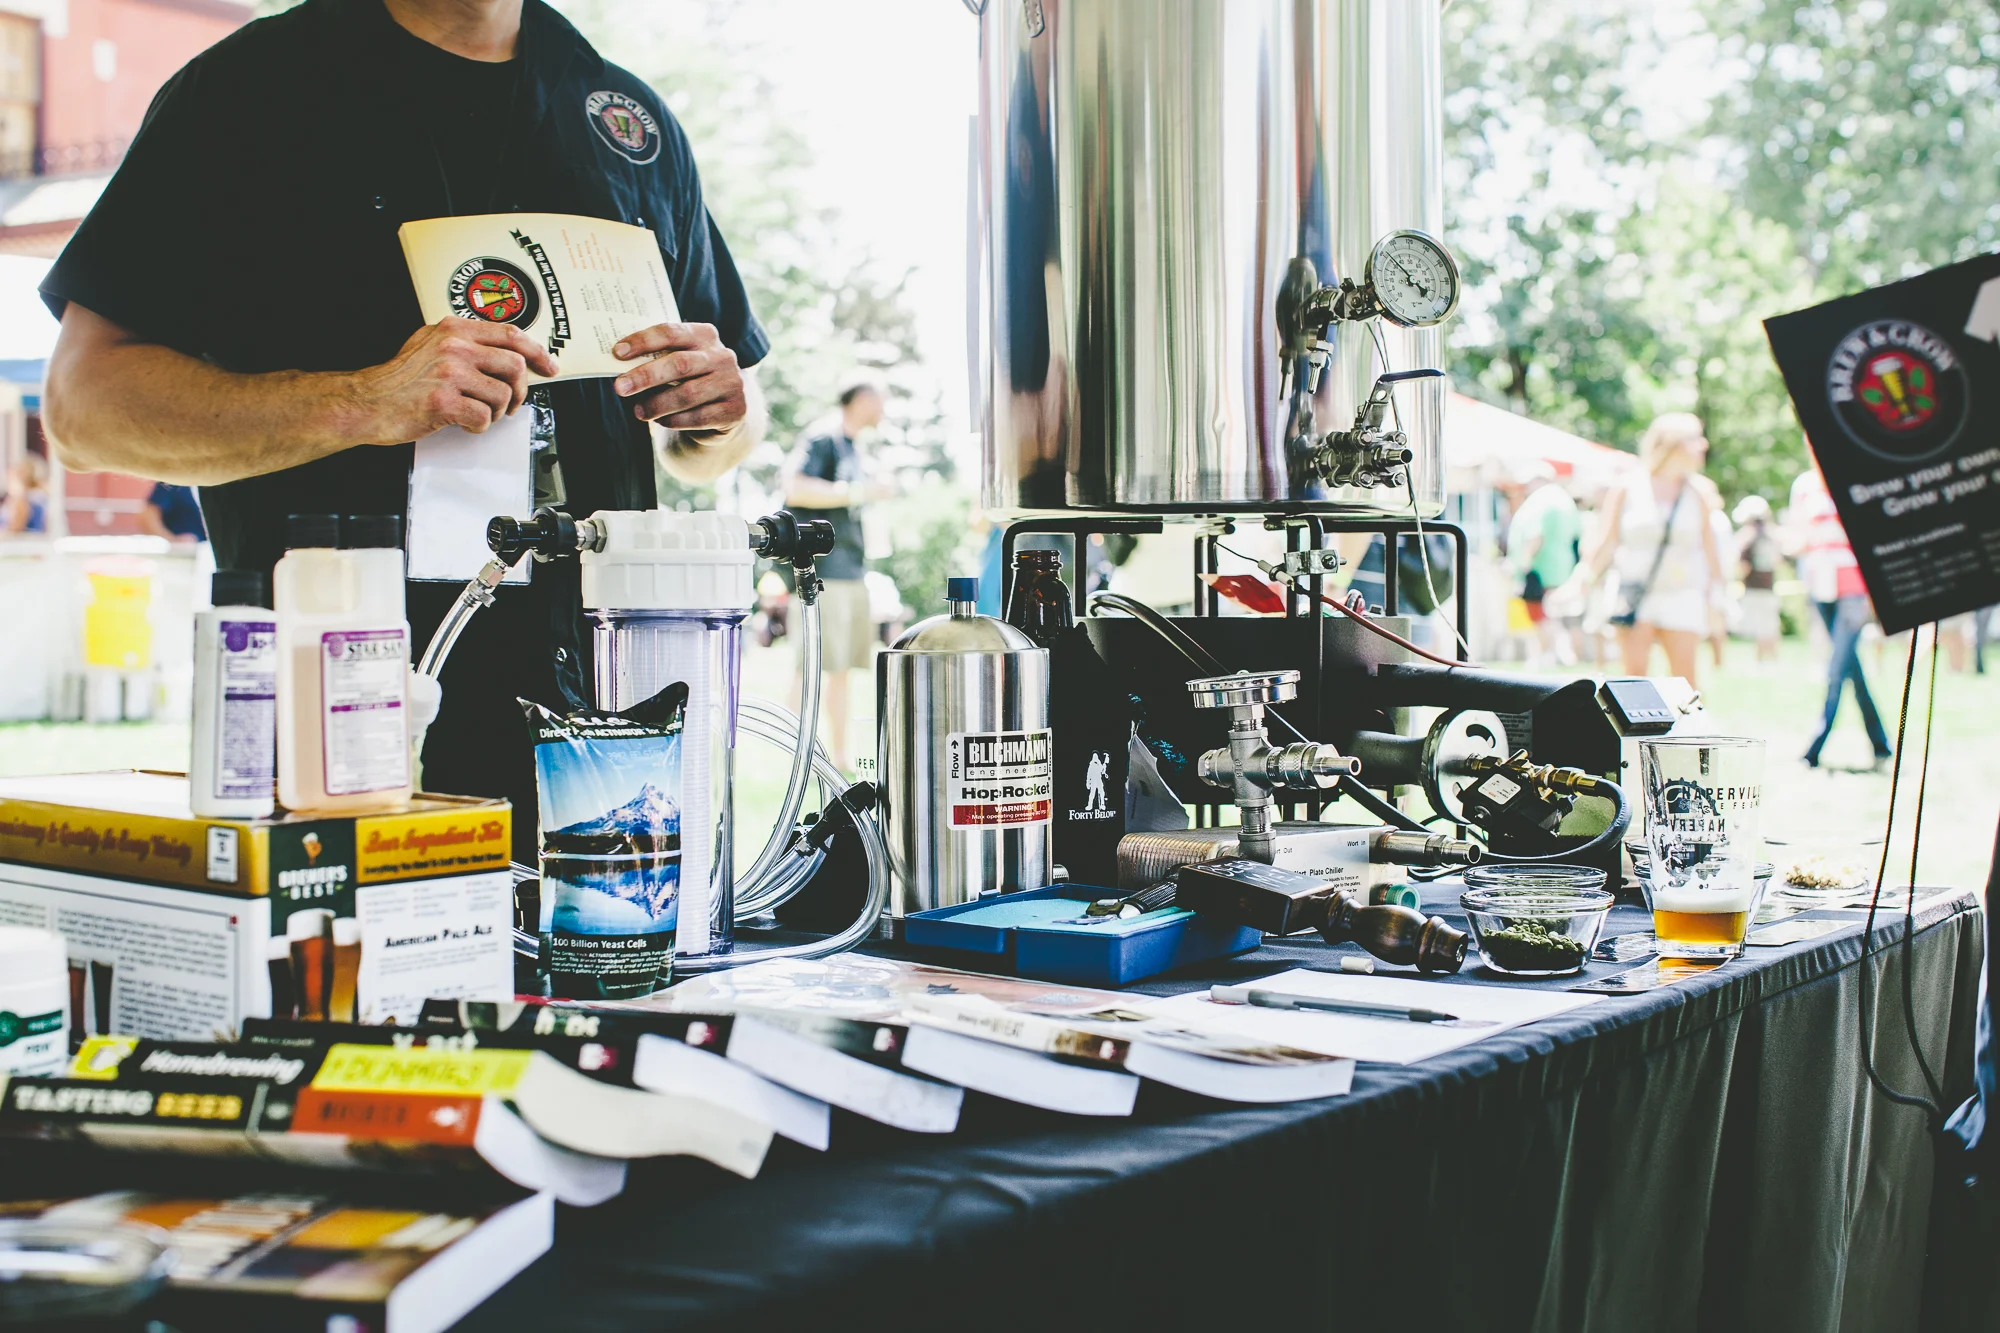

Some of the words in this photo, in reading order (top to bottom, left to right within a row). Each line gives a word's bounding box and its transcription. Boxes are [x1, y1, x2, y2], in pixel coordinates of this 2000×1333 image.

[450, 260, 484, 293] GROW
[539, 727, 571, 739] Direct
[969, 739, 1046, 764] BLICHMANN
[952, 753, 960, 778] Flow
[970, 765, 1046, 776] engneering
[962, 782, 1050, 801] HopRocket
[1069, 809, 1093, 820] FORTY
[1309, 868, 1324, 876] Plate
[1325, 867, 1344, 875] Chiller
[552, 937, 569, 947] 100
[570, 939, 599, 949] Billion
[600, 939, 625, 949] Yeast
[626, 938, 647, 949] Cells
[141, 1050, 305, 1085] Homebrewing
[14, 1085, 153, 1116] TASTING
[155, 1092, 243, 1120] BEER
